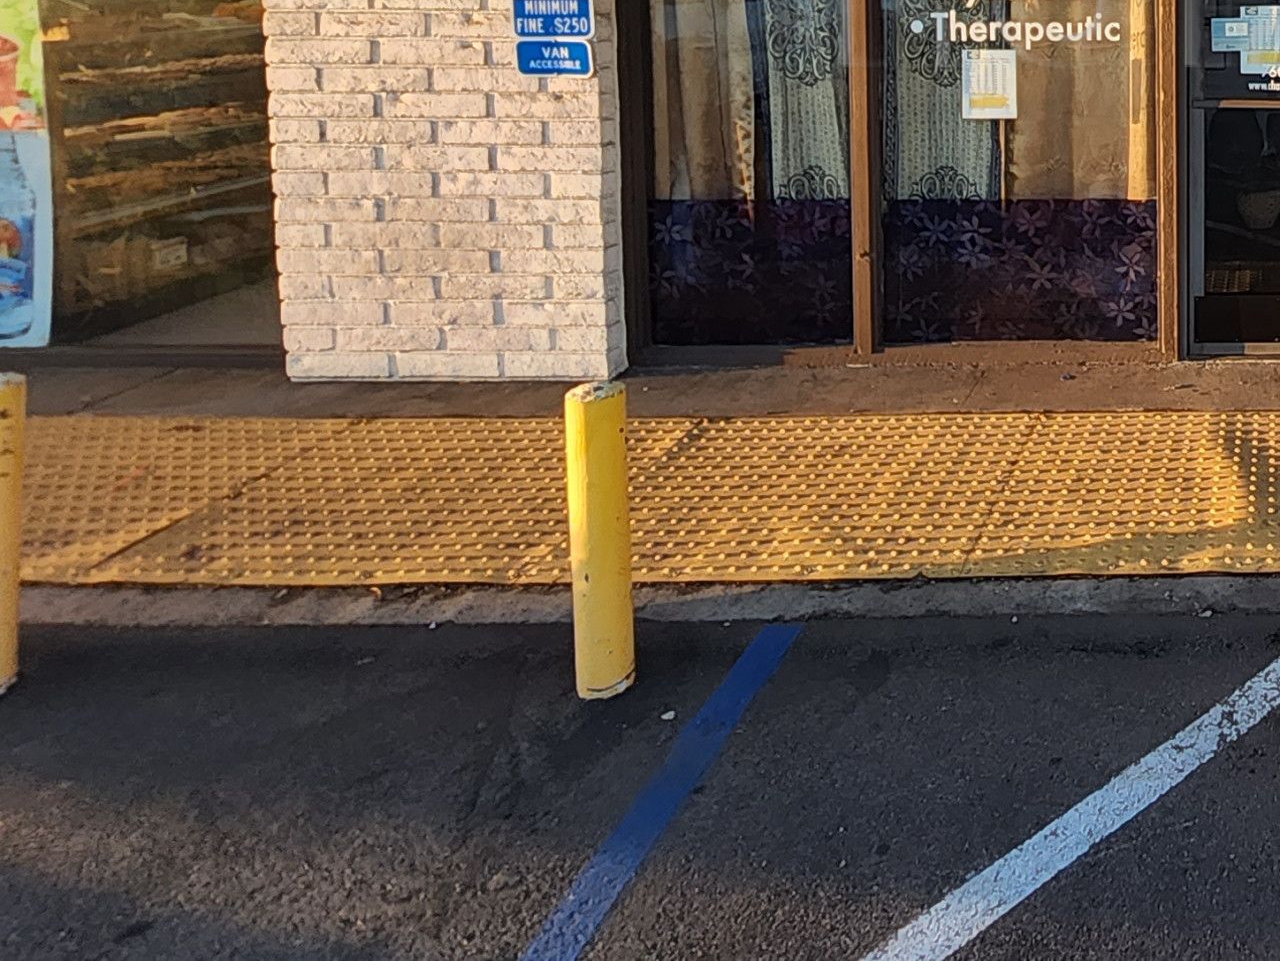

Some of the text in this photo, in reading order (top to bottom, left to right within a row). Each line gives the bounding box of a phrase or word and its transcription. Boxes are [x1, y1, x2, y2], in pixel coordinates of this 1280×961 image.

[524, 0, 579, 15] MINIMUM
[516, 17, 588, 34] FINE $250
[929, 13, 1122, 50] Therapeutic
[541, 46, 570, 59] VAN
[529, 60, 582, 70] ACCESSIBLE
